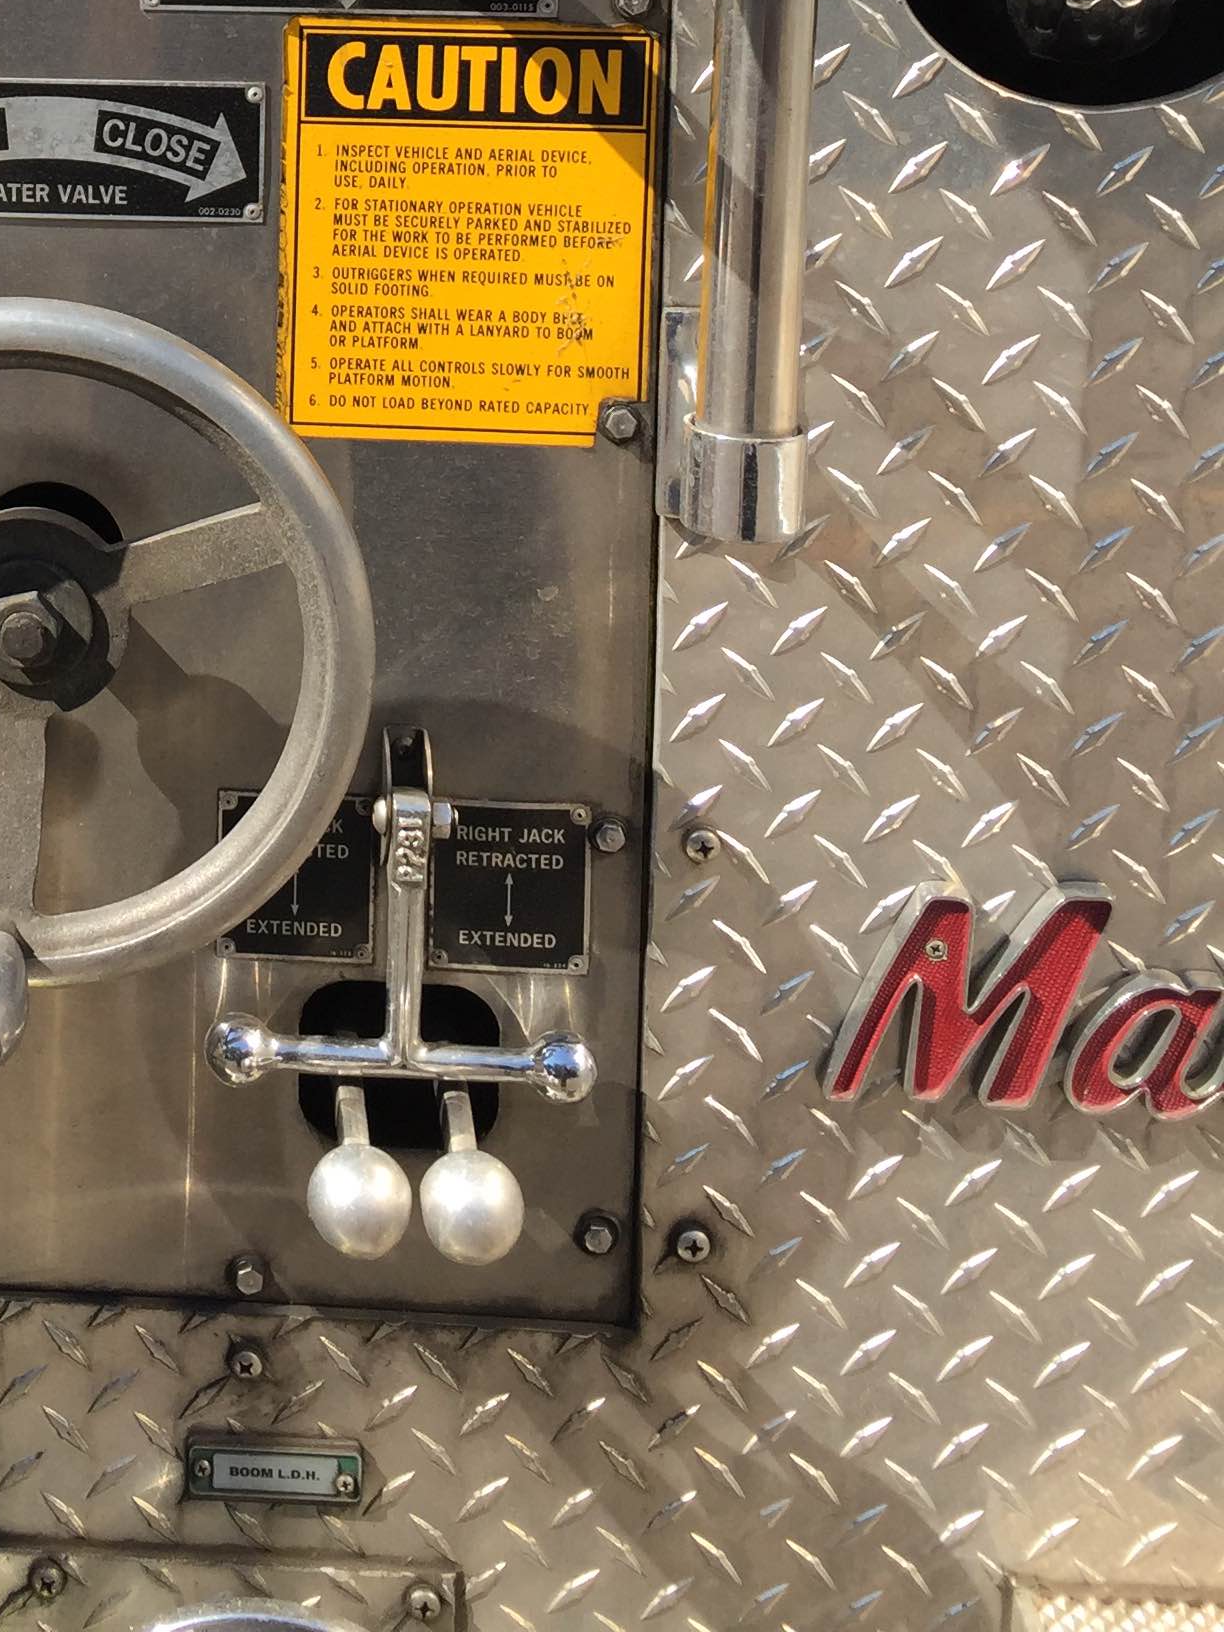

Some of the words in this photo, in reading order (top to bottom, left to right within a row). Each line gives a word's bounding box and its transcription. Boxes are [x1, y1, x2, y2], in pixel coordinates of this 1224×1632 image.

[326, 40, 623, 116] CAUTION
[101, 118, 213, 173] CLOSE
[336, 144, 390, 160] INSPECT
[395, 145, 449, 161] VEHICLE
[454, 147, 483, 162] AND
[488, 147, 535, 164] AERIAL
[540, 149, 592, 165] DEVICE,
[334, 159, 407, 175] INCLUDING
[496, 163, 537, 178] PRIOR
[541, 165, 558, 179] TO
[57, 184, 128, 205] VALVE
[456, 824, 513, 843] RIGHT
[518, 826, 566, 845] JACK
[456, 850, 564, 869] RETRACTED
[246, 918, 342, 938] EXTENDED
[459, 930, 556, 949] EXTENDED
[229, 1466, 274, 1479] BOOM
[277, 1468, 320, 1481] L.D.H.
